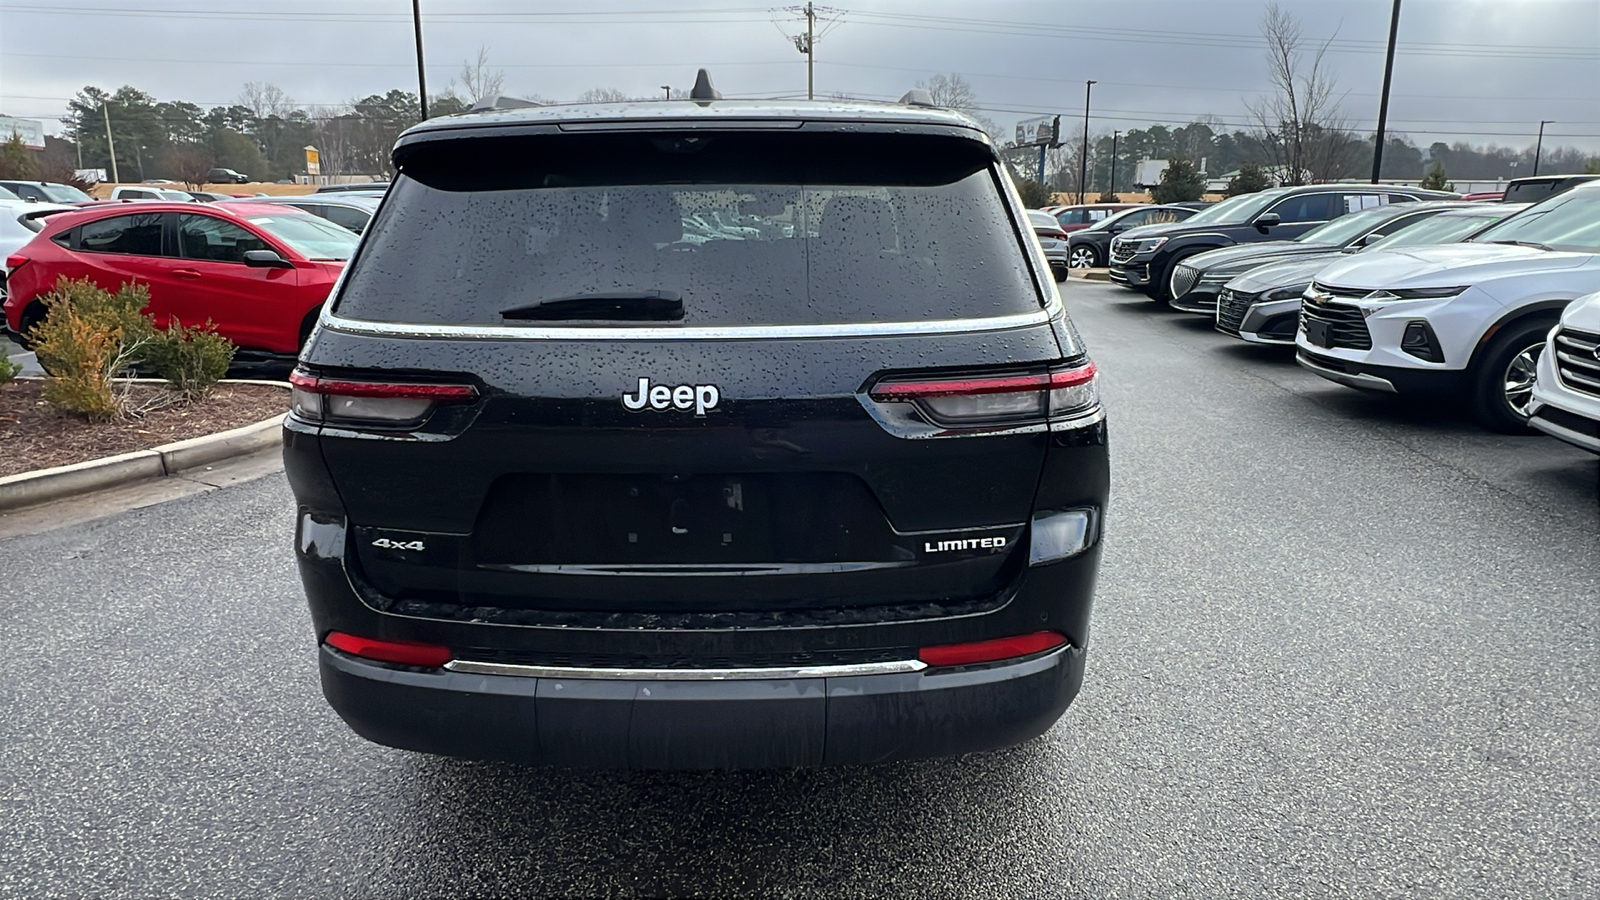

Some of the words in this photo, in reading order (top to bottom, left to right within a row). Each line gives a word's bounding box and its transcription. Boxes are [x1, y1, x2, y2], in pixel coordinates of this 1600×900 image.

[623, 378, 719, 415] Jeep
[371, 538, 426, 551] 4x4
[924, 537, 1006, 553] LIMITED
